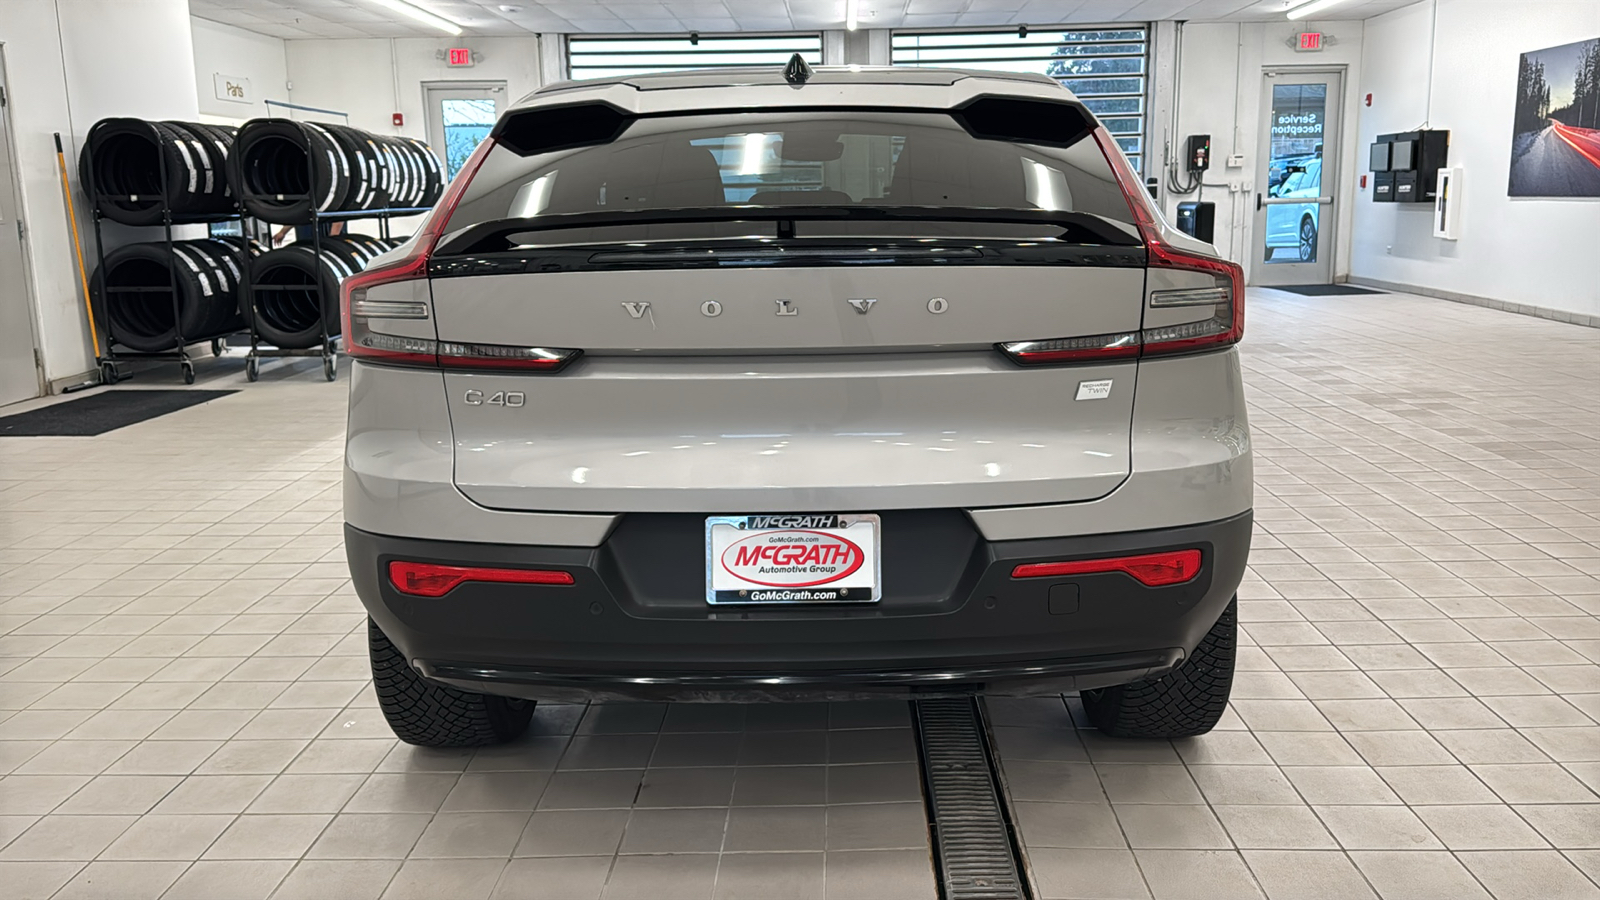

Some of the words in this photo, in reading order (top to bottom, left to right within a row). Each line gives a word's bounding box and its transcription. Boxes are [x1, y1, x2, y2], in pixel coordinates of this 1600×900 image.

[1301, 33, 1320, 48] EXIT
[450, 48, 469, 65] EXIT
[226, 81, 244, 98] Parts
[621, 297, 949, 319] VOLVO
[752, 515, 833, 529] McGRATH
[769, 536, 819, 544] GoMcGrath.com
[734, 544, 851, 567] McGRATH
[758, 565, 807, 574] Automotive
[809, 565, 837, 574] Group
[750, 590, 837, 601] GoMcGrath.com
